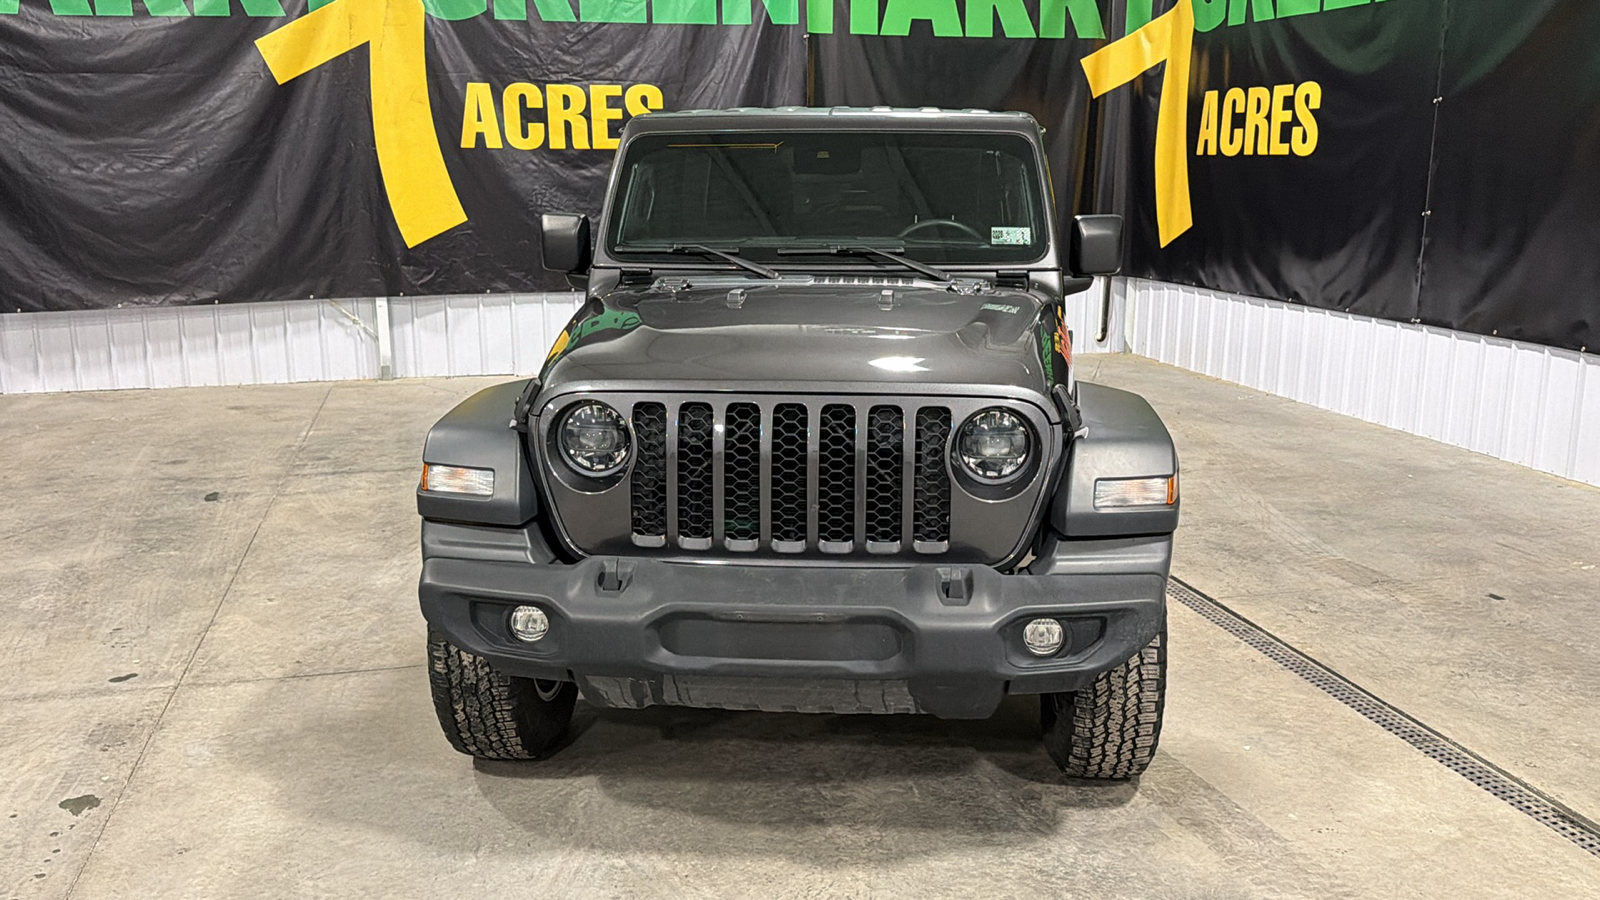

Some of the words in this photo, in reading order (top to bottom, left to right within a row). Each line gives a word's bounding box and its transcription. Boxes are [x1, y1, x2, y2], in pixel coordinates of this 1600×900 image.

[254, 0, 468, 249] 7
[1080, 0, 1193, 249] 7
[1196, 80, 1322, 157] ACRES
